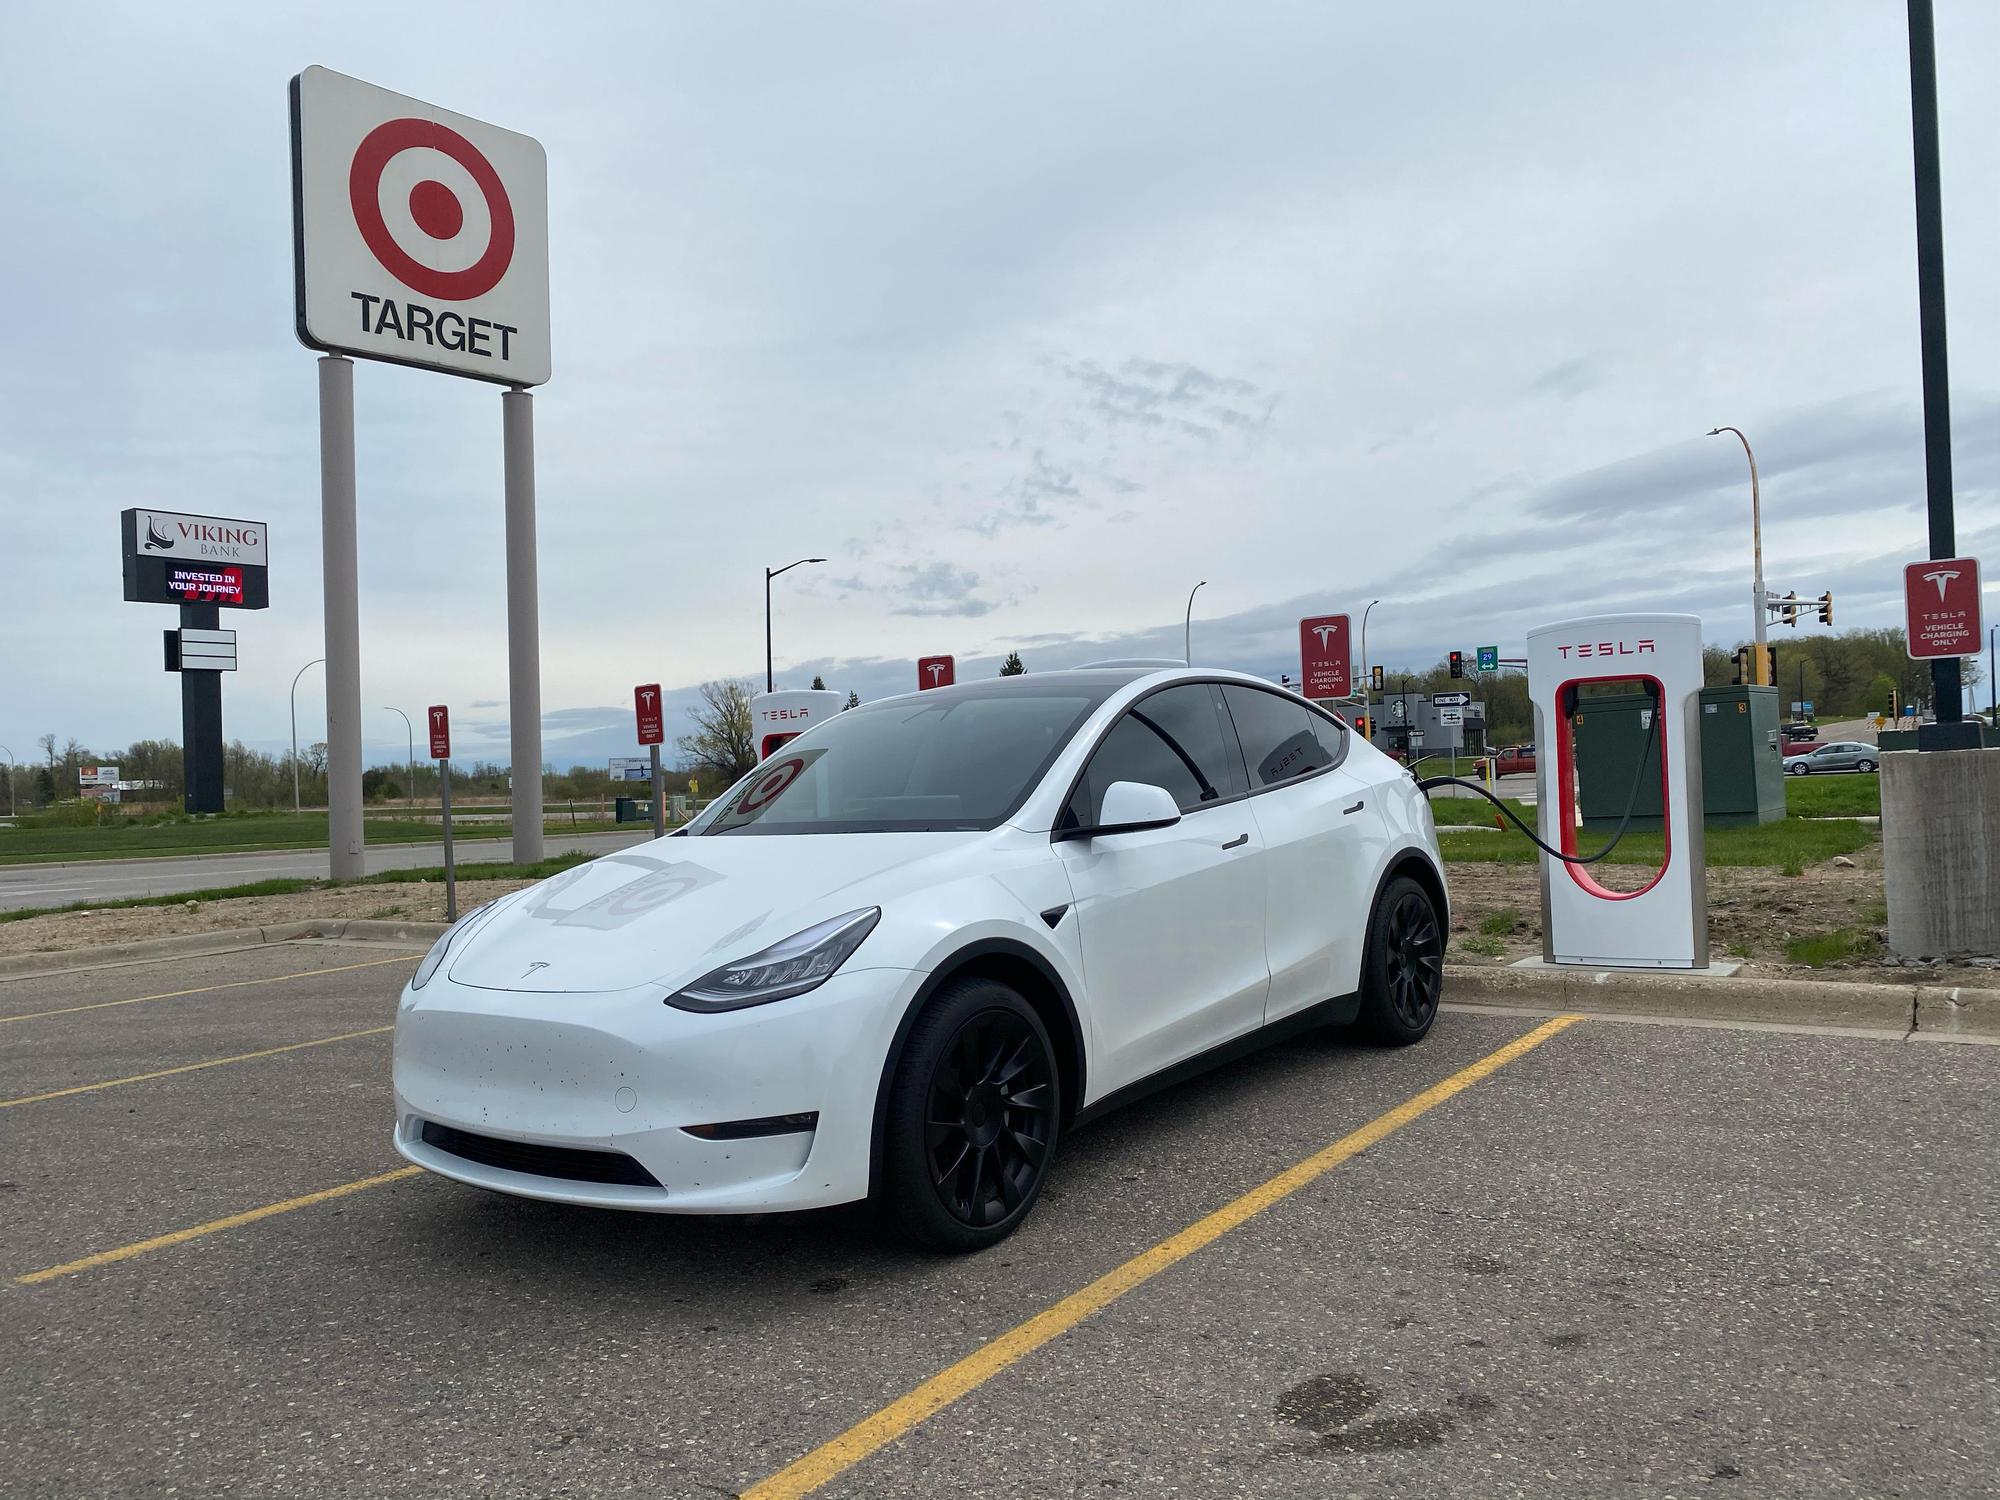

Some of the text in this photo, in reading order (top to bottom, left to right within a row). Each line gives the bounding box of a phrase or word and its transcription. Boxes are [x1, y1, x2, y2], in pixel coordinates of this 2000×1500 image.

[351, 291, 518, 361] TARGET
[177, 522, 258, 546] VIKING
[200, 543, 240, 558] BANK
[174, 570, 235, 584] INVESTED IN
[168, 581, 241, 594] YOUR JOURNEY
[1921, 611, 1966, 620] TESLA
[1925, 622, 1965, 632] VEHICLE
[1920, 630, 1970, 640] CHARGING
[1932, 638, 1959, 647] ONLY
[1557, 638, 1656, 660] TESLA
[1482, 653, 1493, 661] 29
[1311, 660, 1341, 668] TESLA
[1313, 670, 1340, 678] VEHICLE
[1310, 676, 1344, 684] CHARGING
[761, 707, 809, 721] TESLA
